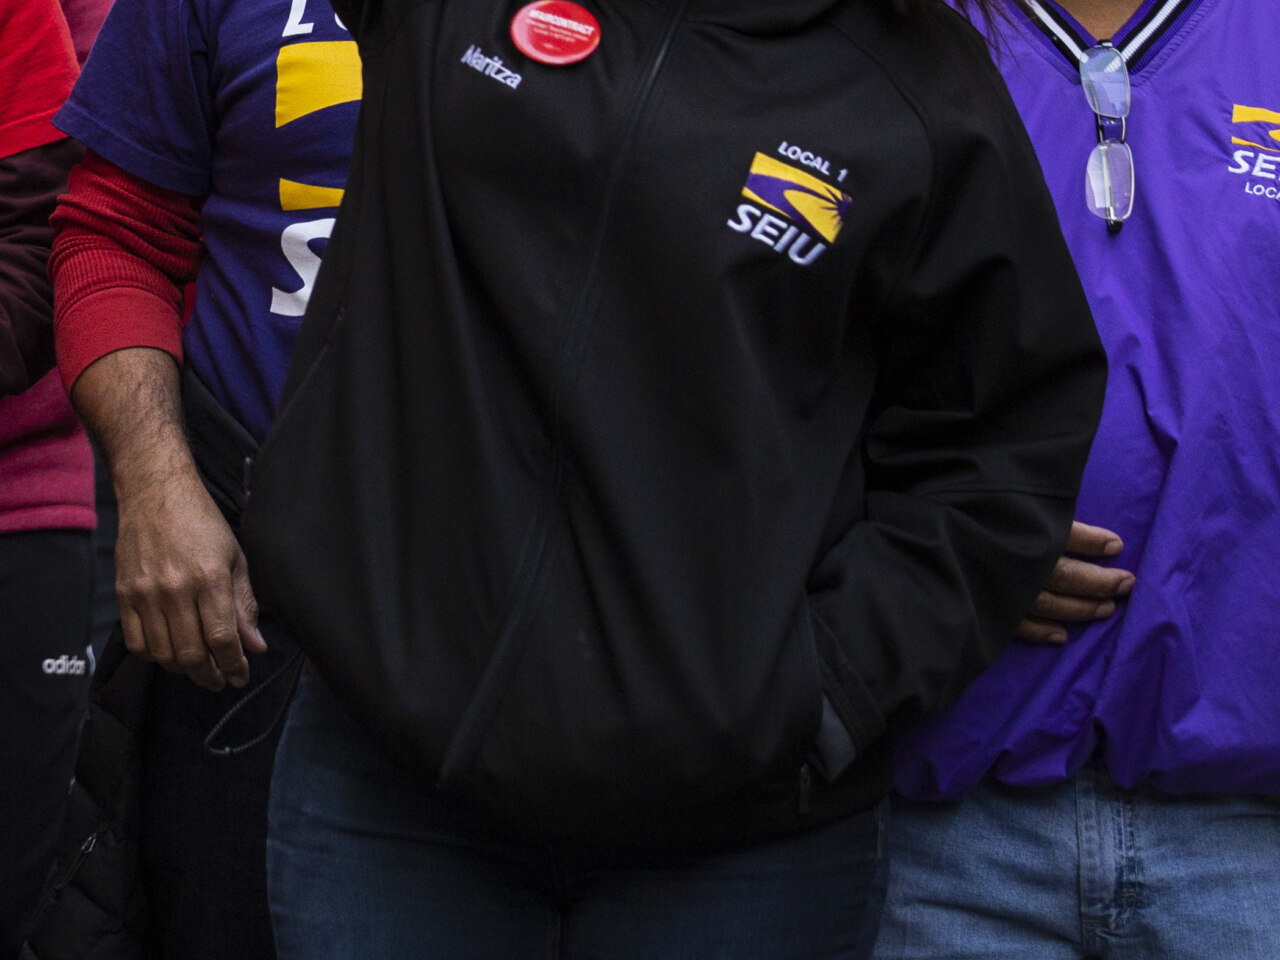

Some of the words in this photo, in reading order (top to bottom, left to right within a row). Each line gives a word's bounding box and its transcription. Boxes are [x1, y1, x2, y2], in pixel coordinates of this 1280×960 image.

[460, 43, 522, 89] Maritza
[777, 141, 830, 176] LOCAL
[837, 168, 849, 183] 1
[727, 204, 827, 266] SEIU
